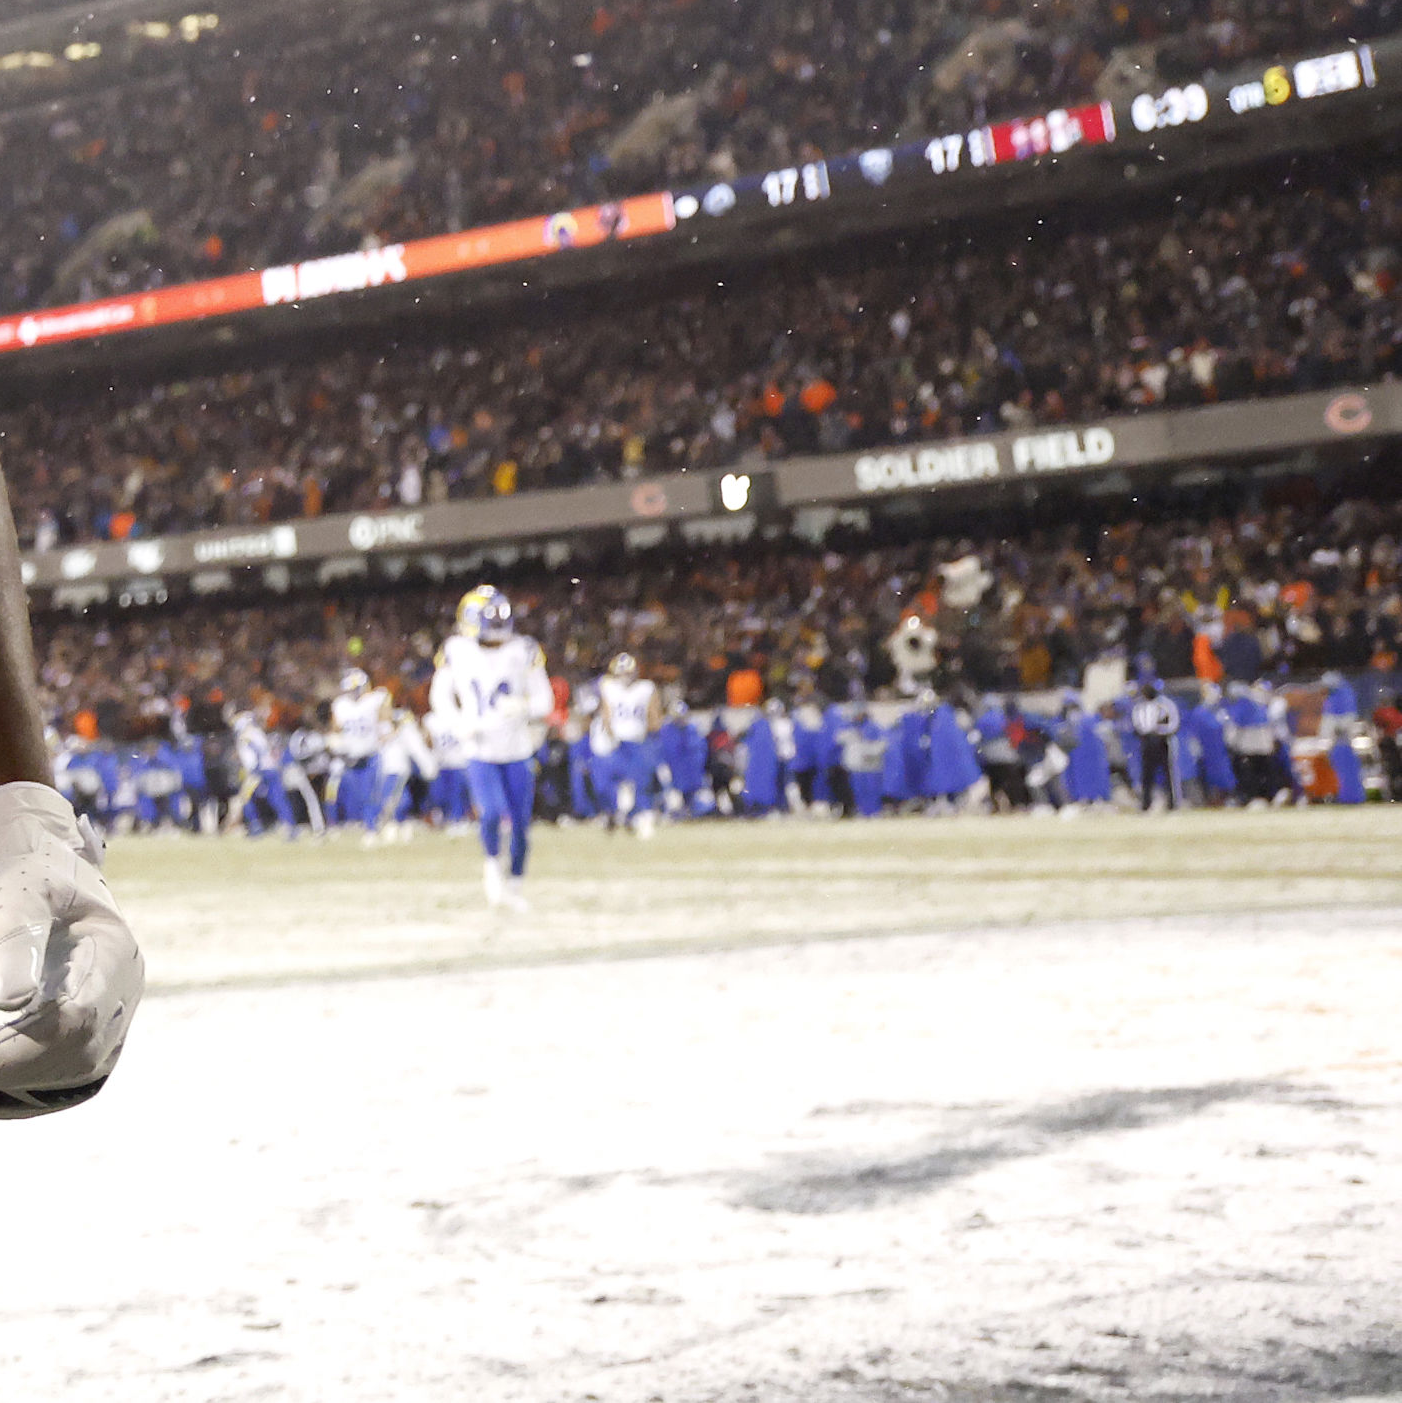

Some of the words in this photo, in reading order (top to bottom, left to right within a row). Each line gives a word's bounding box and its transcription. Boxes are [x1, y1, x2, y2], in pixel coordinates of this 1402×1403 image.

[925, 133, 963, 175] 17
[761, 167, 799, 207] 17
[854, 442, 999, 492] SOLDIER
[1011, 427, 1115, 474] FIELD
